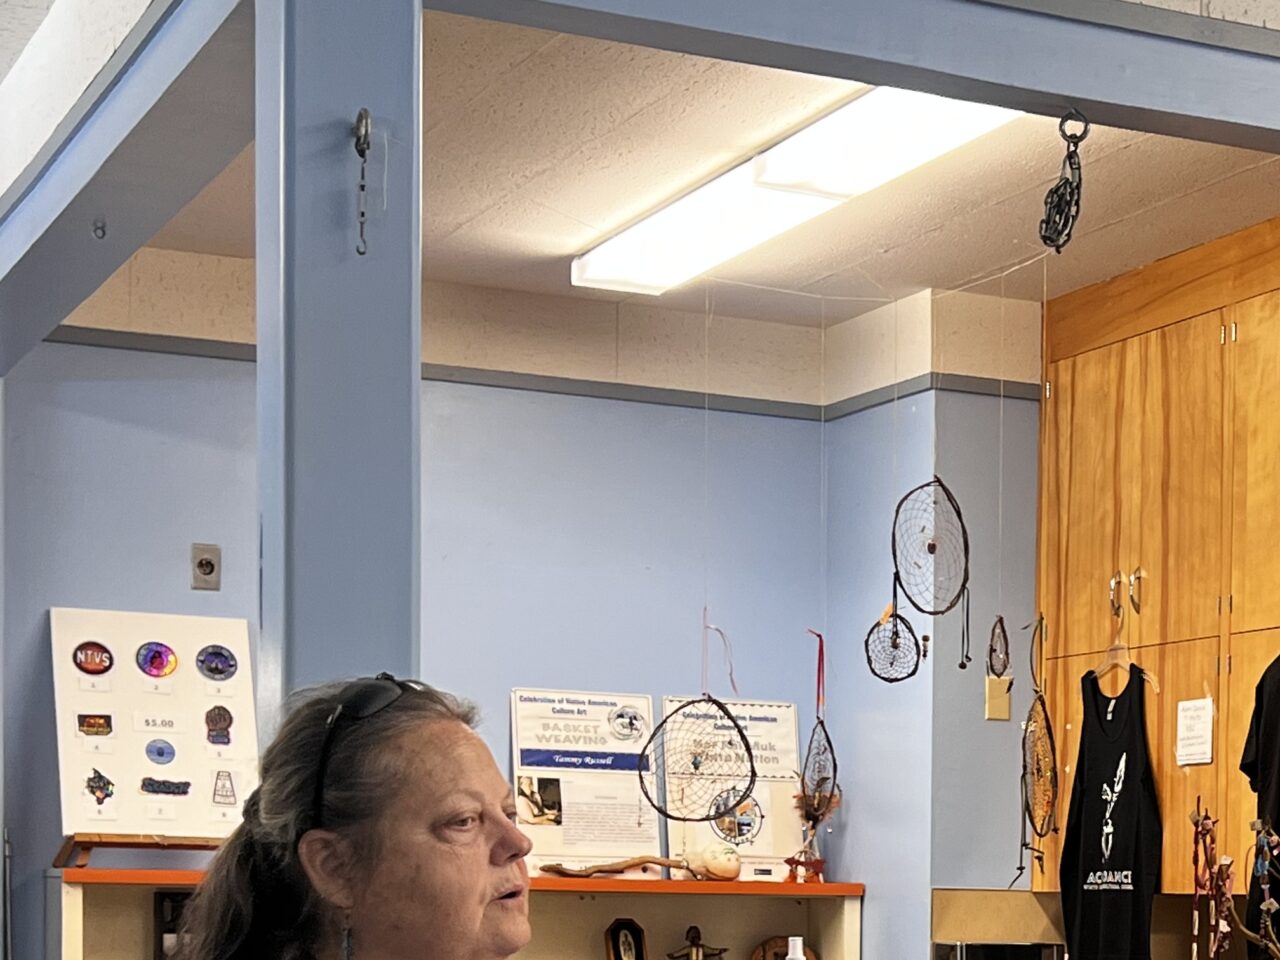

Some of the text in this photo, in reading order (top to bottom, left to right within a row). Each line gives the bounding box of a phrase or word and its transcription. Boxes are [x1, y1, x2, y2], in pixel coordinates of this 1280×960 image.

[76, 650, 111, 667] NTVS
[519, 695, 556, 704] Celebration
[565, 697, 586, 706] Native
[588, 699, 617, 707] American
[552, 707, 587, 716] Culture Art
[144, 718, 174, 728] $5.00
[749, 715, 778, 723] American
[542, 723, 600, 735] BASKET
[536, 733, 608, 746] WEAVING
[553, 754, 614, 766] Tammy Russell
